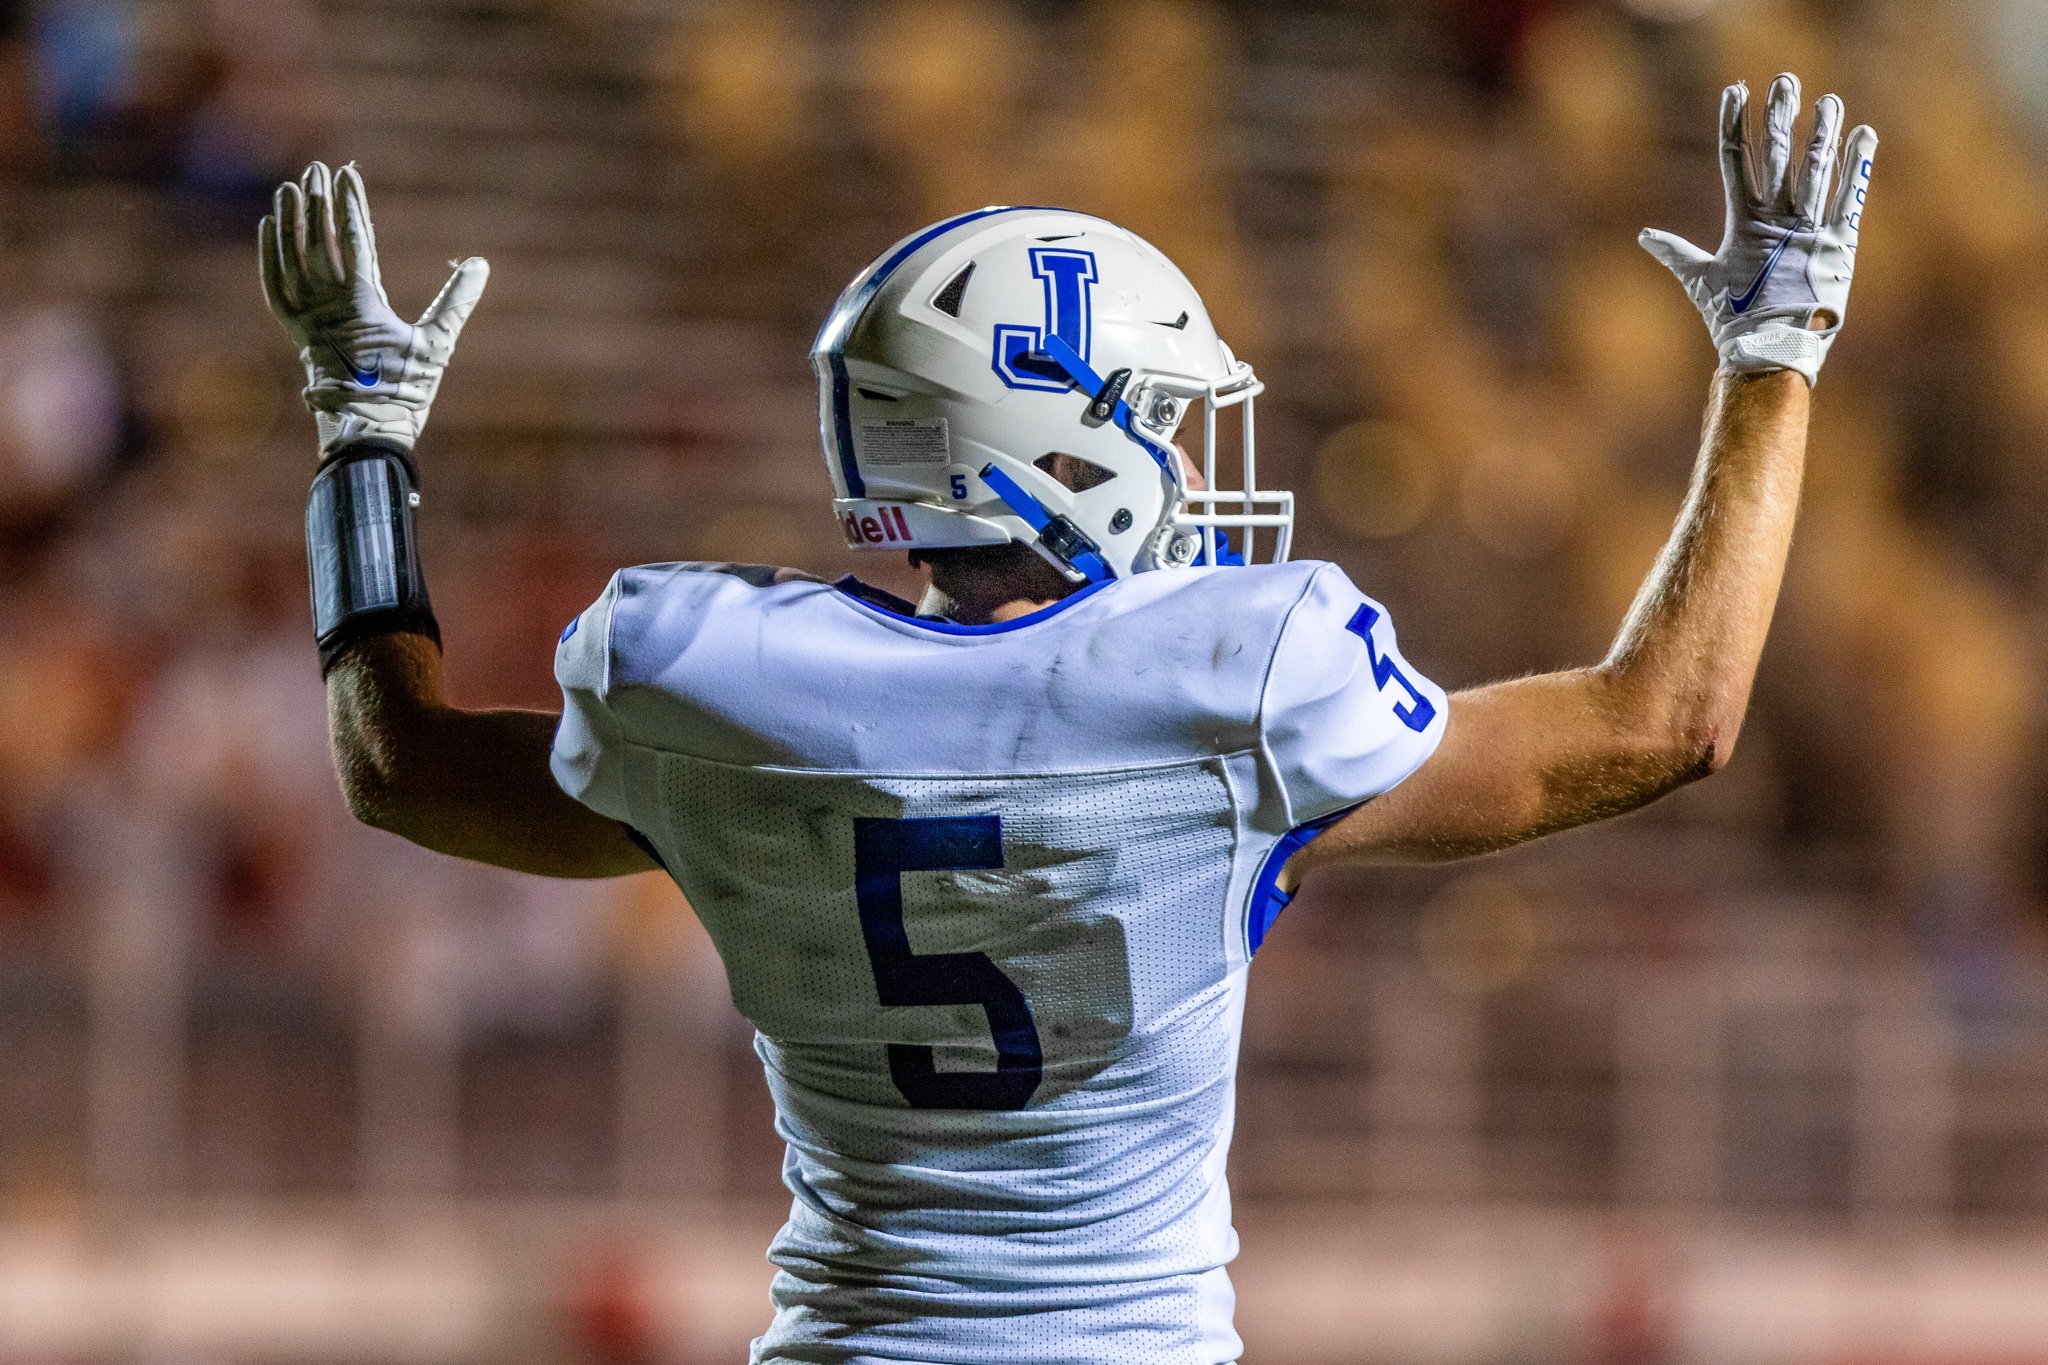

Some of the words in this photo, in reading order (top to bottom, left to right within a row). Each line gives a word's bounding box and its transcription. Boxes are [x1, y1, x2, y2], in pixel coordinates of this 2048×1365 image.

[991, 247, 1099, 394] J
[837, 506, 913, 544] dell
[950, 474, 967, 499] 5
[1345, 602, 1437, 733] 5
[853, 815, 1043, 1110] 5
